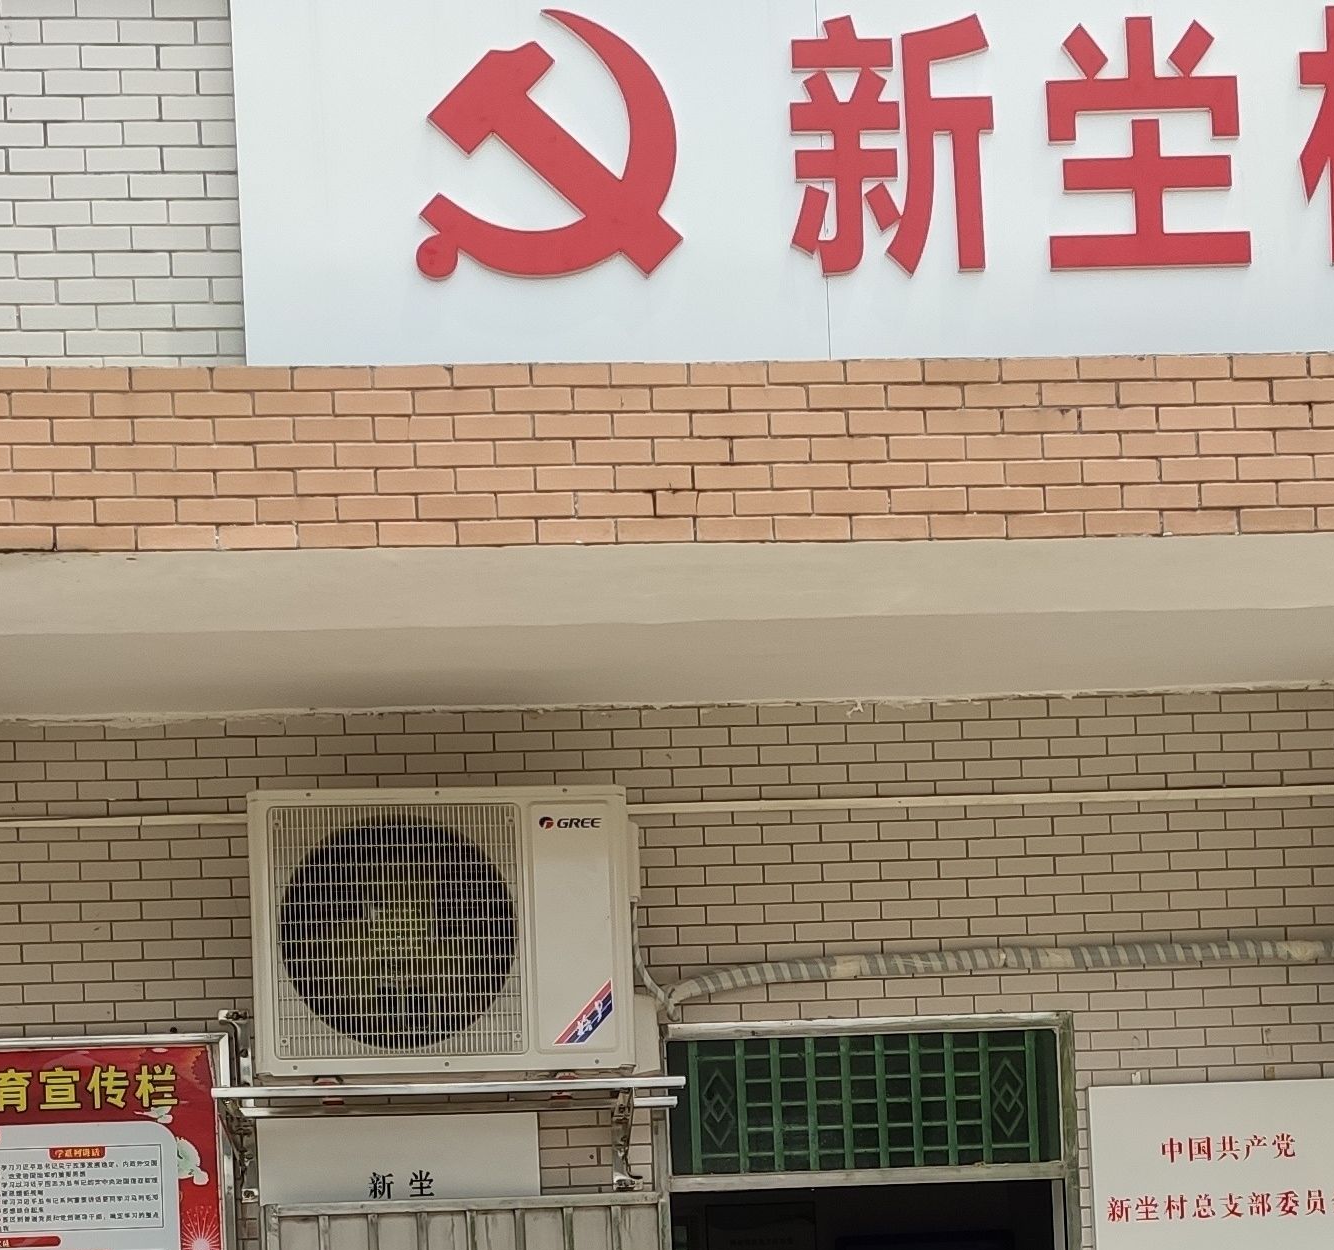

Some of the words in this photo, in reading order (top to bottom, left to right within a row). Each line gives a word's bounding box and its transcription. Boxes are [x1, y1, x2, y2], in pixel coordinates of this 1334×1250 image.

[556, 816, 603, 830] GREE
[1160, 1132, 1297, 1164] 中国共产党
